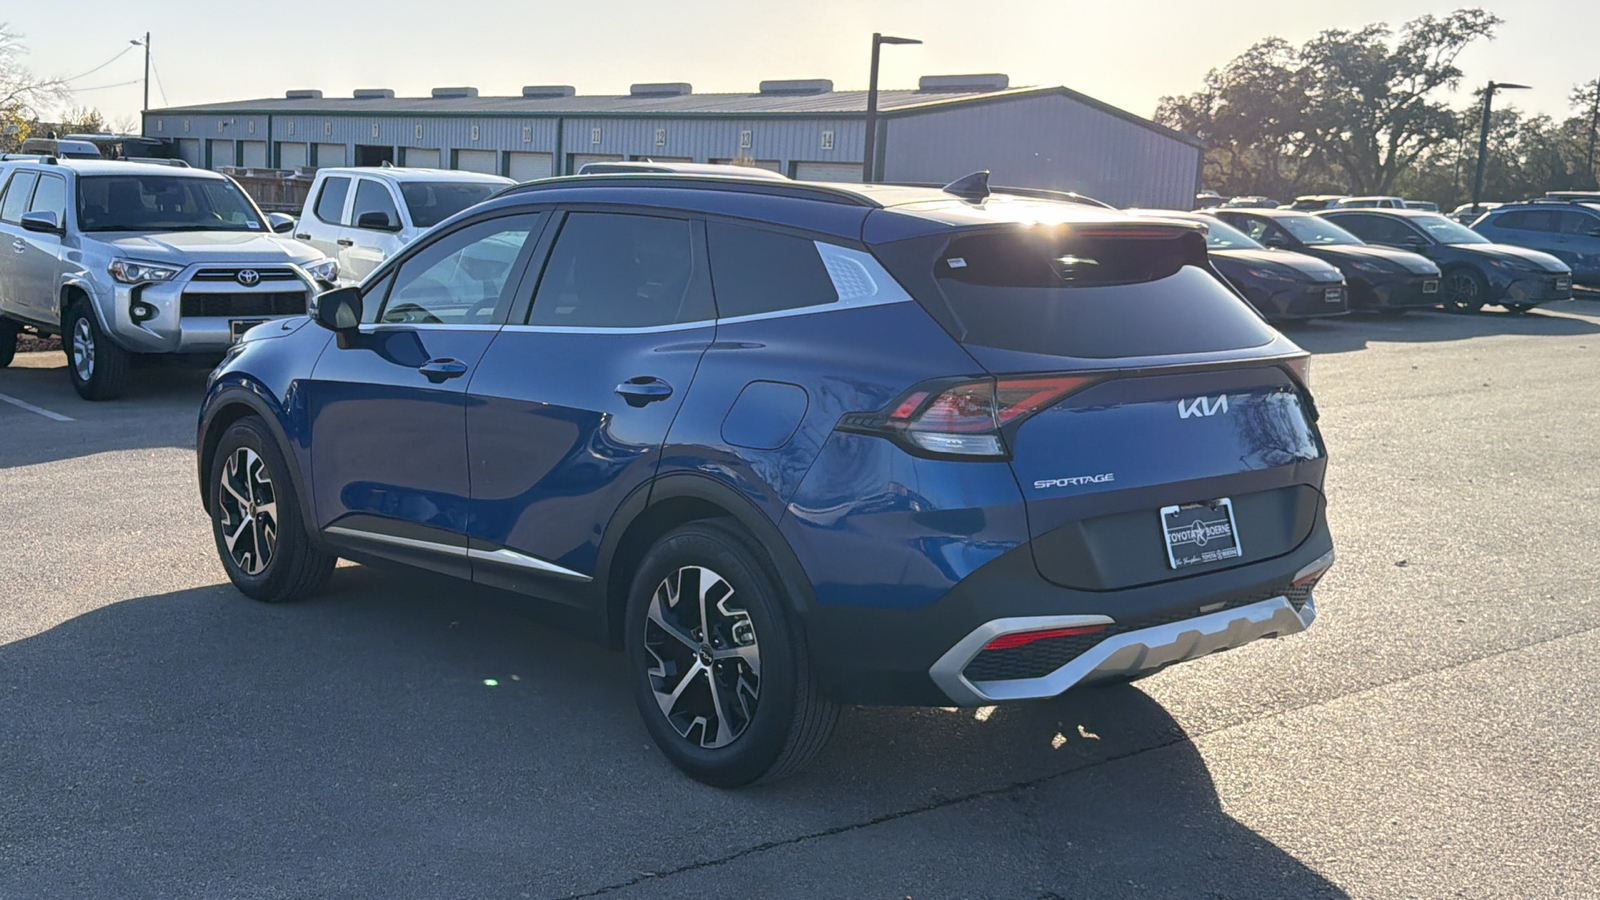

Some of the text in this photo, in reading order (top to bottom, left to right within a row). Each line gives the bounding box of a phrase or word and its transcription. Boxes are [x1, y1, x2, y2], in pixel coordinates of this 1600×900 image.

[656, 131, 665, 144] 12
[741, 132, 750, 146] 13
[822, 133, 832, 148] 14
[1178, 394, 1228, 419] KIA
[1033, 473, 1115, 489] SPORTAGE
[1168, 523, 1231, 543] TOYOTA BOERNE
